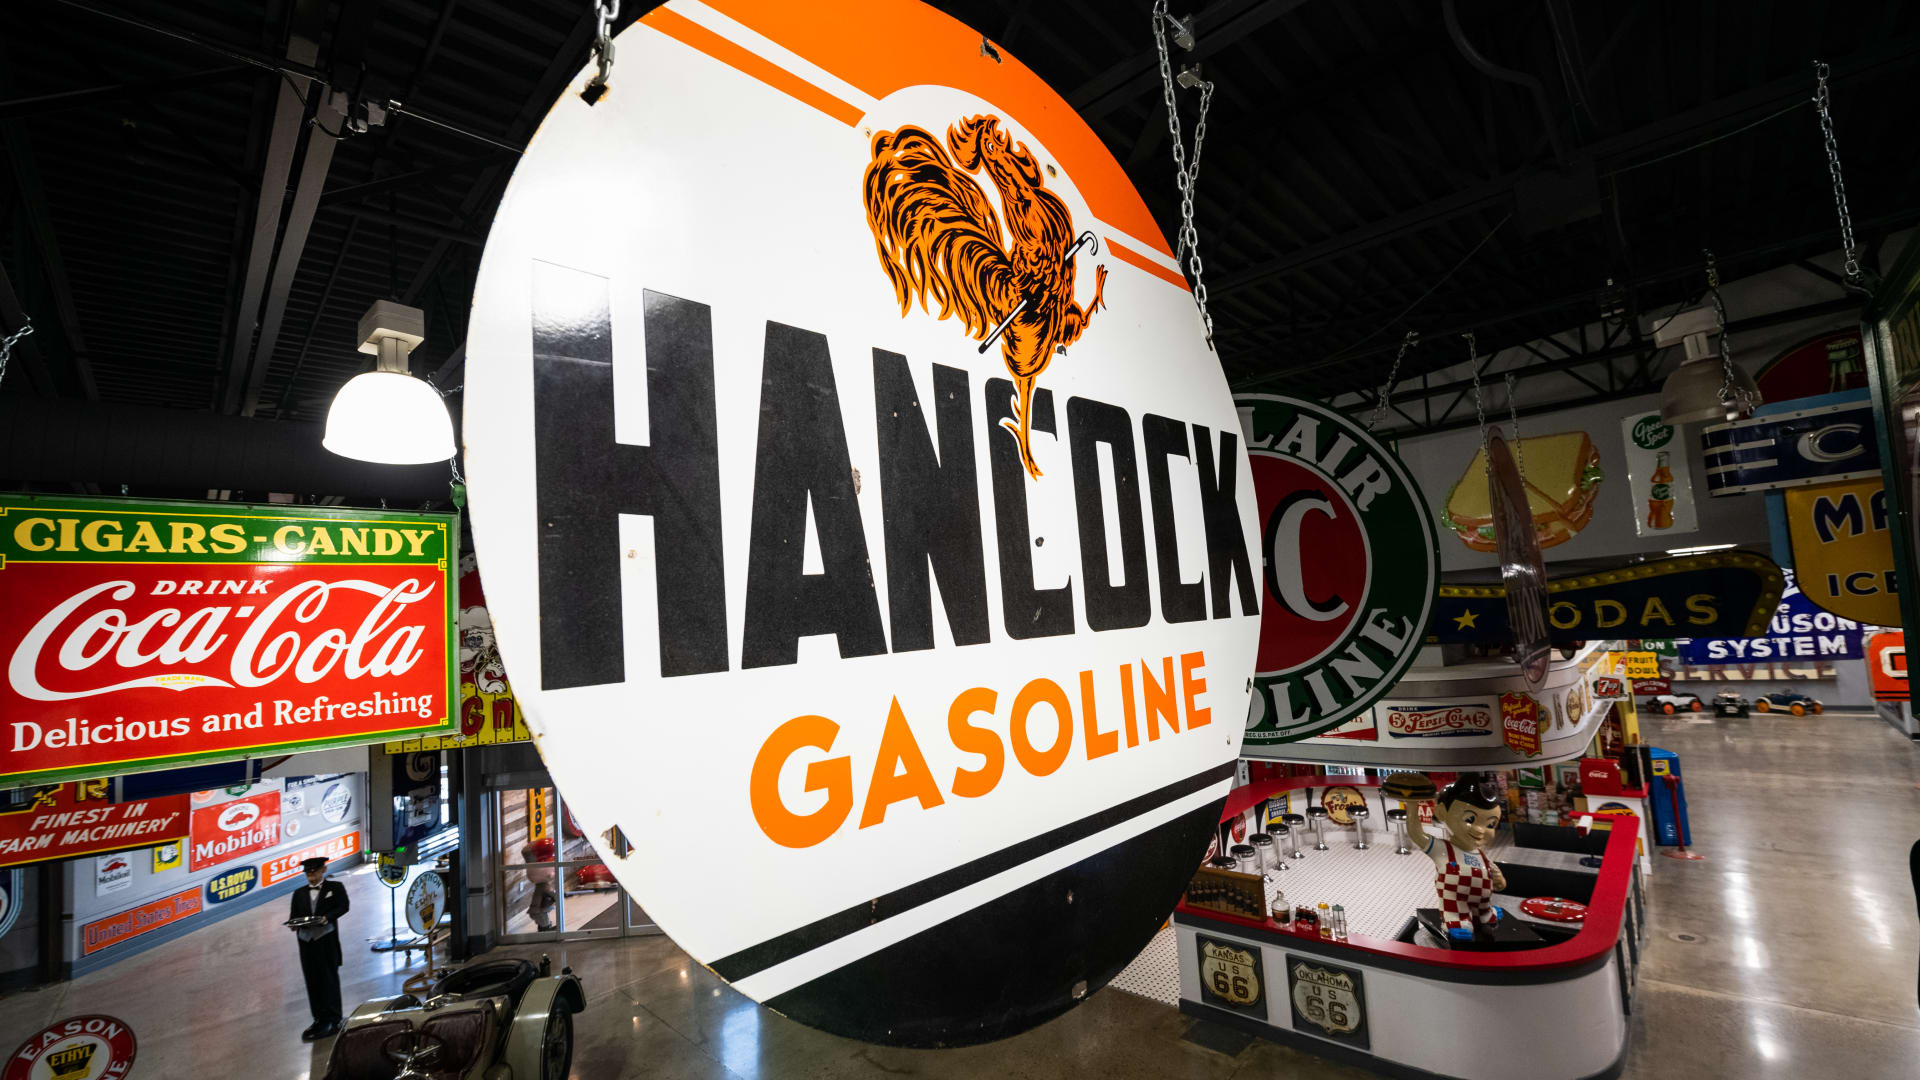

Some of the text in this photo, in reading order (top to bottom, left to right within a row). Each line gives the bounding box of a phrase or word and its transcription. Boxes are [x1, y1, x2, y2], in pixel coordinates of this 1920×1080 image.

[532, 259, 1260, 691] HANCOCK
[150, 579, 273, 596] DRINK
[8, 577, 436, 701] Coca-Cola
[1707, 634, 1848, 659] SYSTEM
[1628, 656, 1654, 664] FRUIT
[11, 691, 433, 752] Delicious and Refreshing
[1504, 716, 1536, 735] Coca-Cola
[750, 650, 1212, 849] GASOLINE
[30, 802, 148, 831] FINEST IN
[195, 823, 277, 862] Mobiloil
[218, 884, 247, 900] TIRES
[408, 871, 442, 906] MARATHON
[88, 913, 134, 946] United
[135, 905, 172, 929] States
[1212, 948, 1244, 963] KANSAS
[1219, 963, 1240, 974] U S
[1213, 971, 1249, 999] 66
[1300, 969, 1350, 989] OKLAHOMA
[1313, 986, 1336, 1000] U S
[1306, 996, 1347, 1026] 66
[17, 1019, 124, 1061] EASON
[51, 1045, 93, 1067] ETHYL
